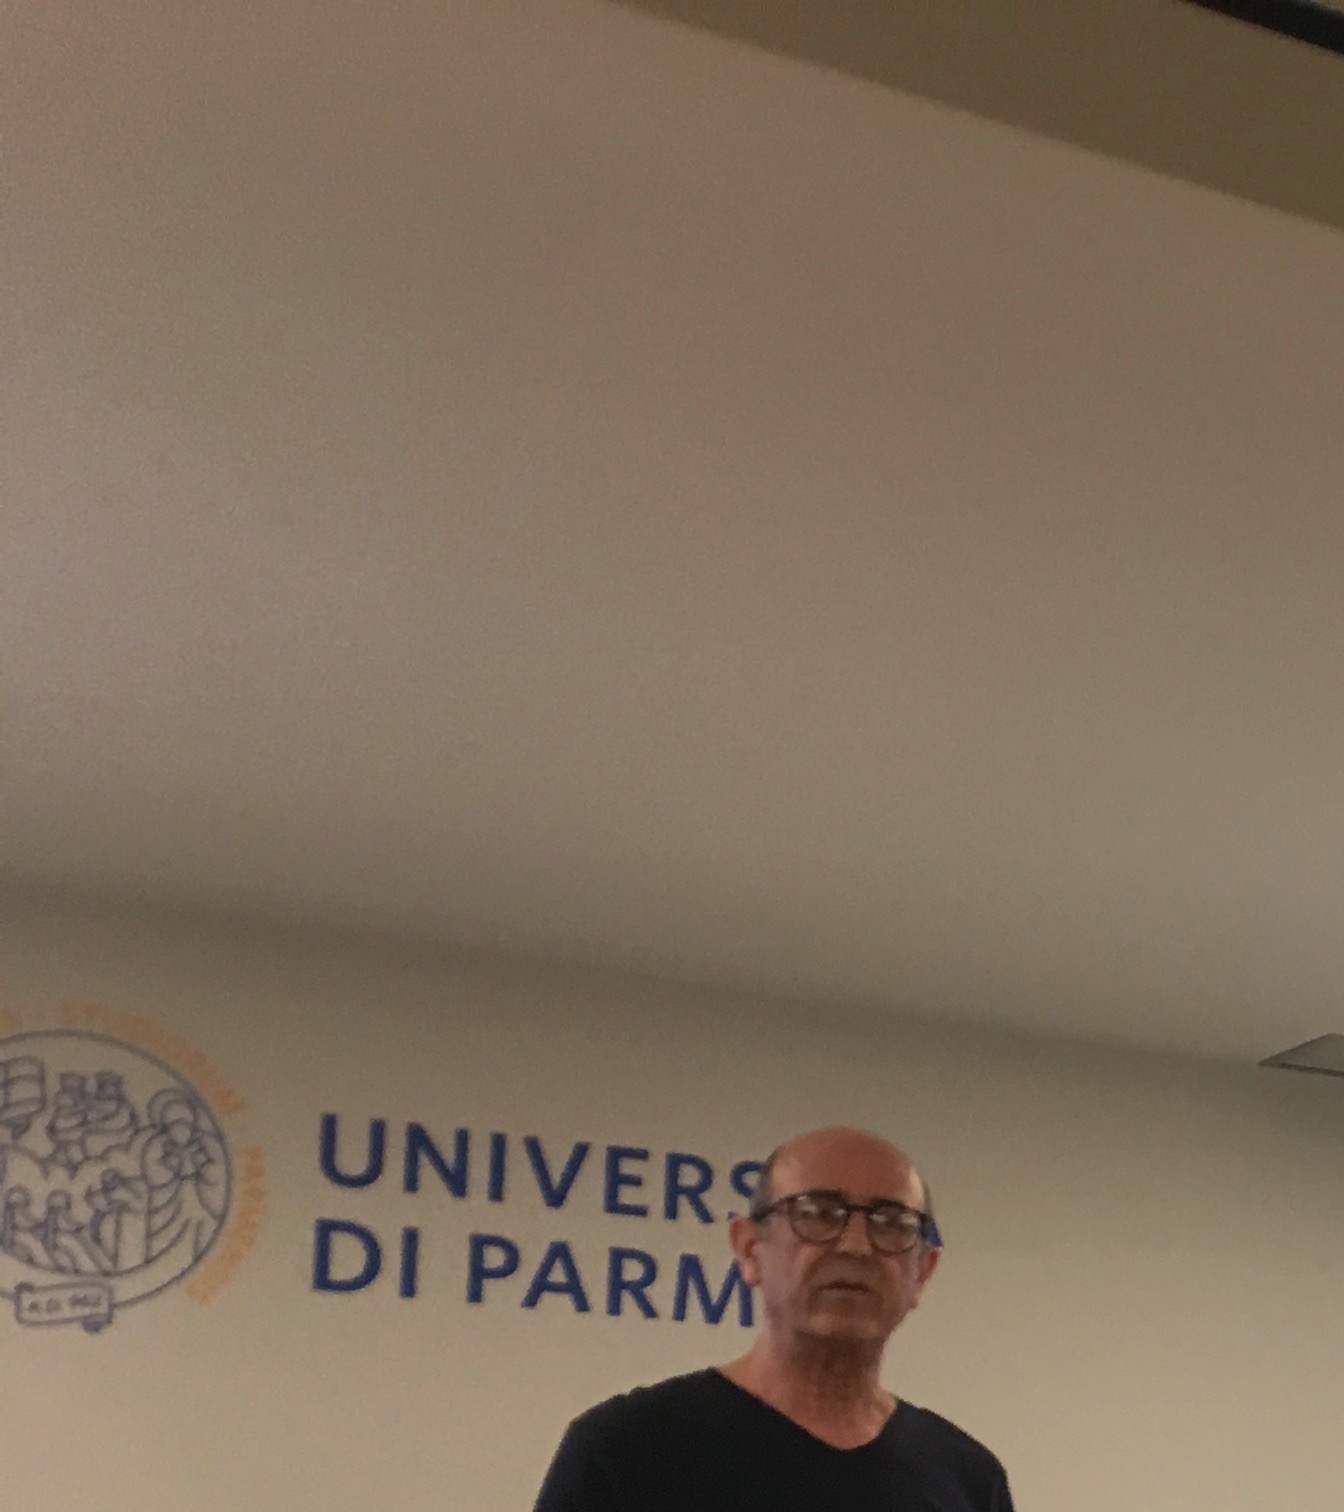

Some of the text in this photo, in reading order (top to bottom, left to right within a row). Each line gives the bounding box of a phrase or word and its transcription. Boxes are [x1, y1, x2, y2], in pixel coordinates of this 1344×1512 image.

[318, 1112, 943, 1248] UNIVERS
[312, 1217, 757, 1329] DI PARM
